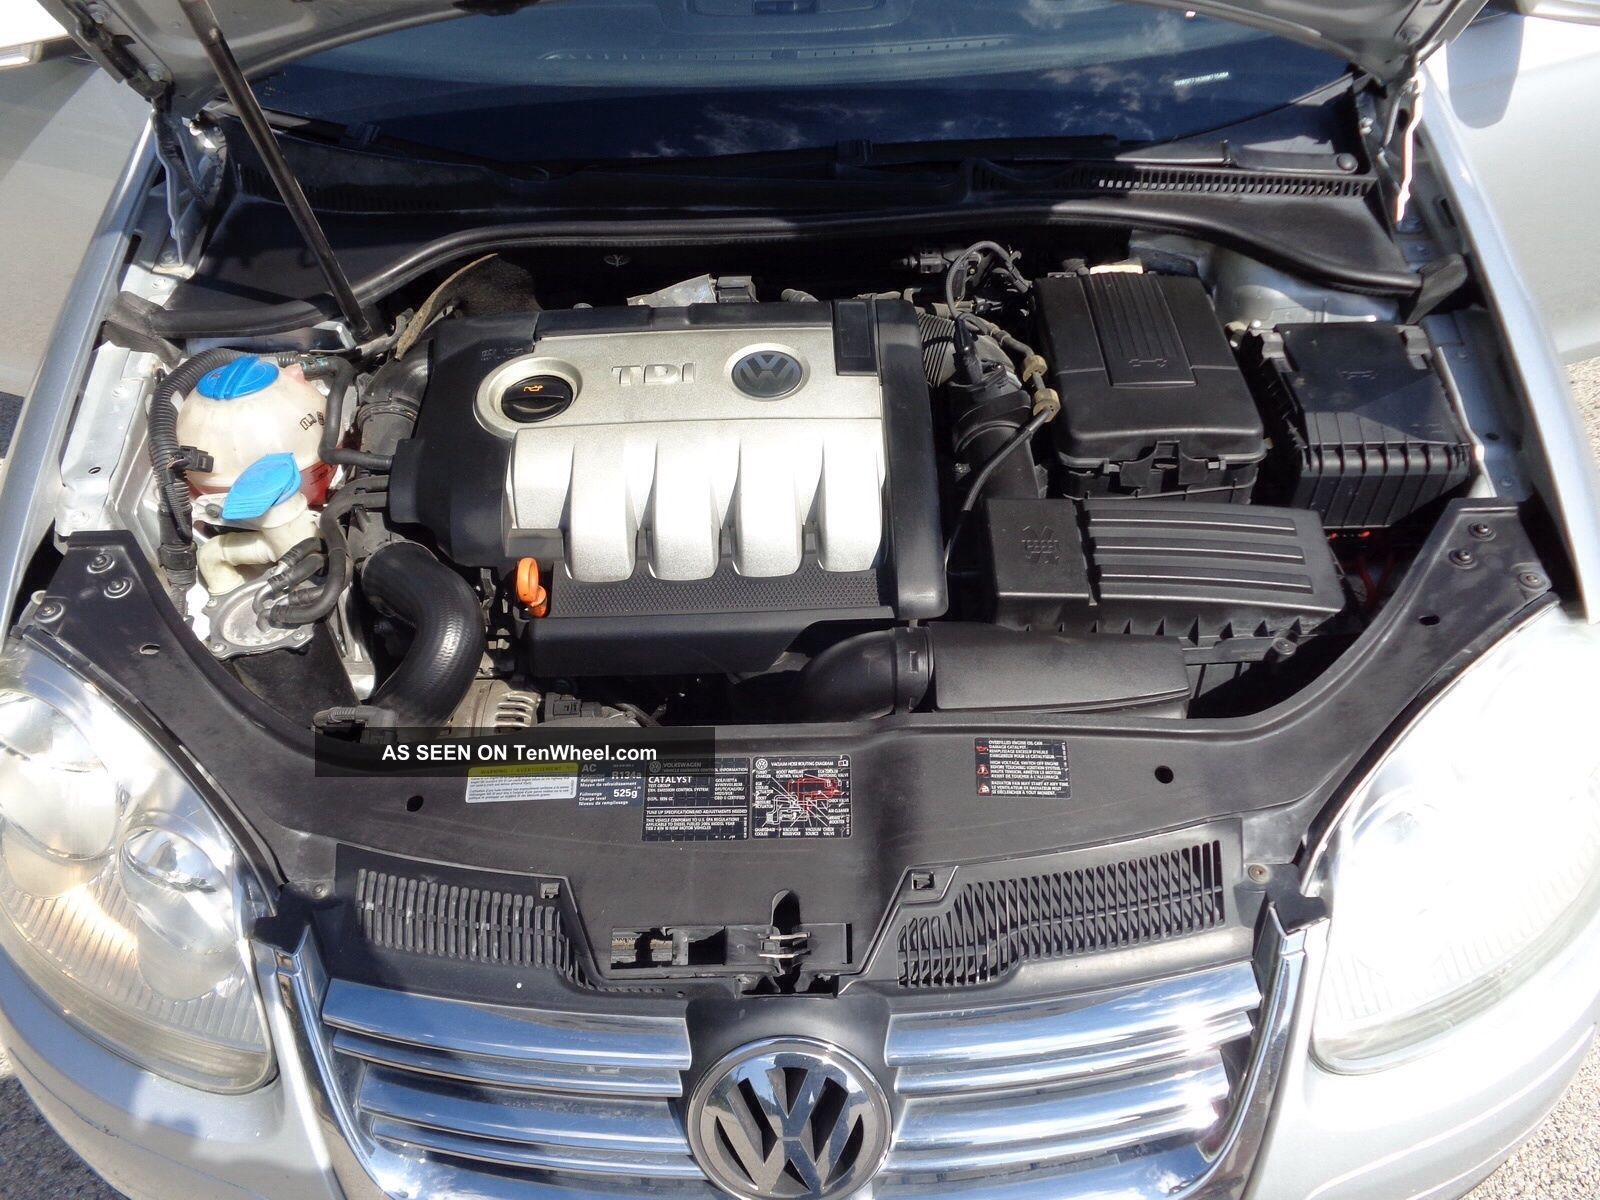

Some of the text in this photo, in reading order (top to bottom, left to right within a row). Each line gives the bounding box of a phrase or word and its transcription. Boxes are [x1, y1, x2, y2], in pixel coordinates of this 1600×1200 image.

[612, 362, 696, 386] TDI
[582, 764, 596, 772] AC
[612, 771, 641, 779] R134a
[614, 789, 638, 798] 525g
[694, 1043, 886, 1199] VW
